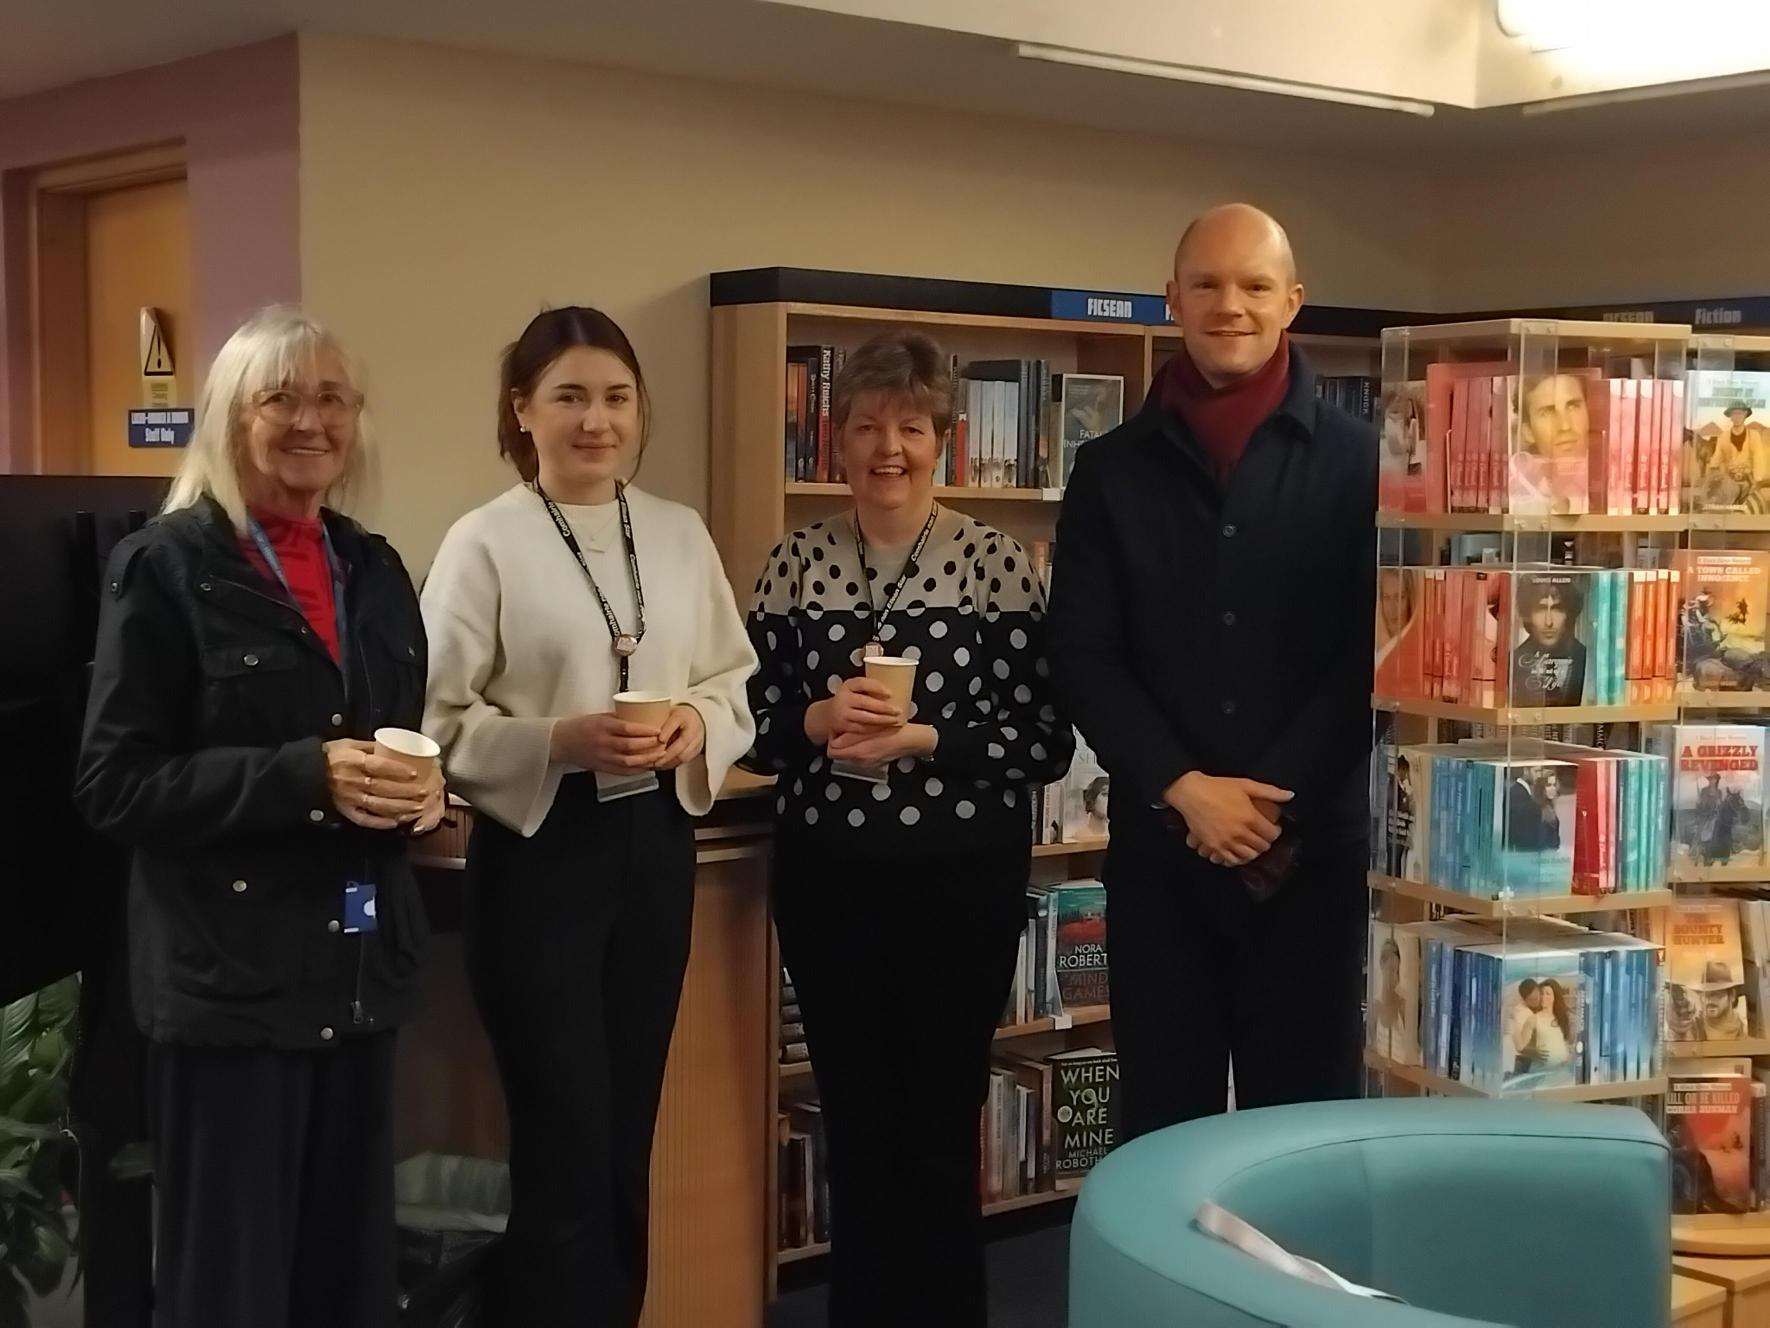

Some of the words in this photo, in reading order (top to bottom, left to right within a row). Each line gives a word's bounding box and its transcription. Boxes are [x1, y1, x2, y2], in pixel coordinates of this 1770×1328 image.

[1695, 307, 1742, 325] Fiction
[821, 382, 832, 416] Reichs
[603, 602, 621, 637] omhairle
[1681, 745, 1693, 757] A
[1697, 745, 1759, 757] GRIZZLY
[1680, 759, 1759, 772] REVENGED
[1673, 934, 1725, 945] HUNTER
[1074, 944, 1103, 954] NORA
[1069, 972, 1108, 986] MIND
[1060, 1064, 1120, 1085] WHEN
[1070, 1086, 1110, 1106] YOU
[1071, 1107, 1108, 1127] ARE
[1064, 1128, 1115, 1149] MINE
[1068, 1147, 1107, 1159] MICHAEL
